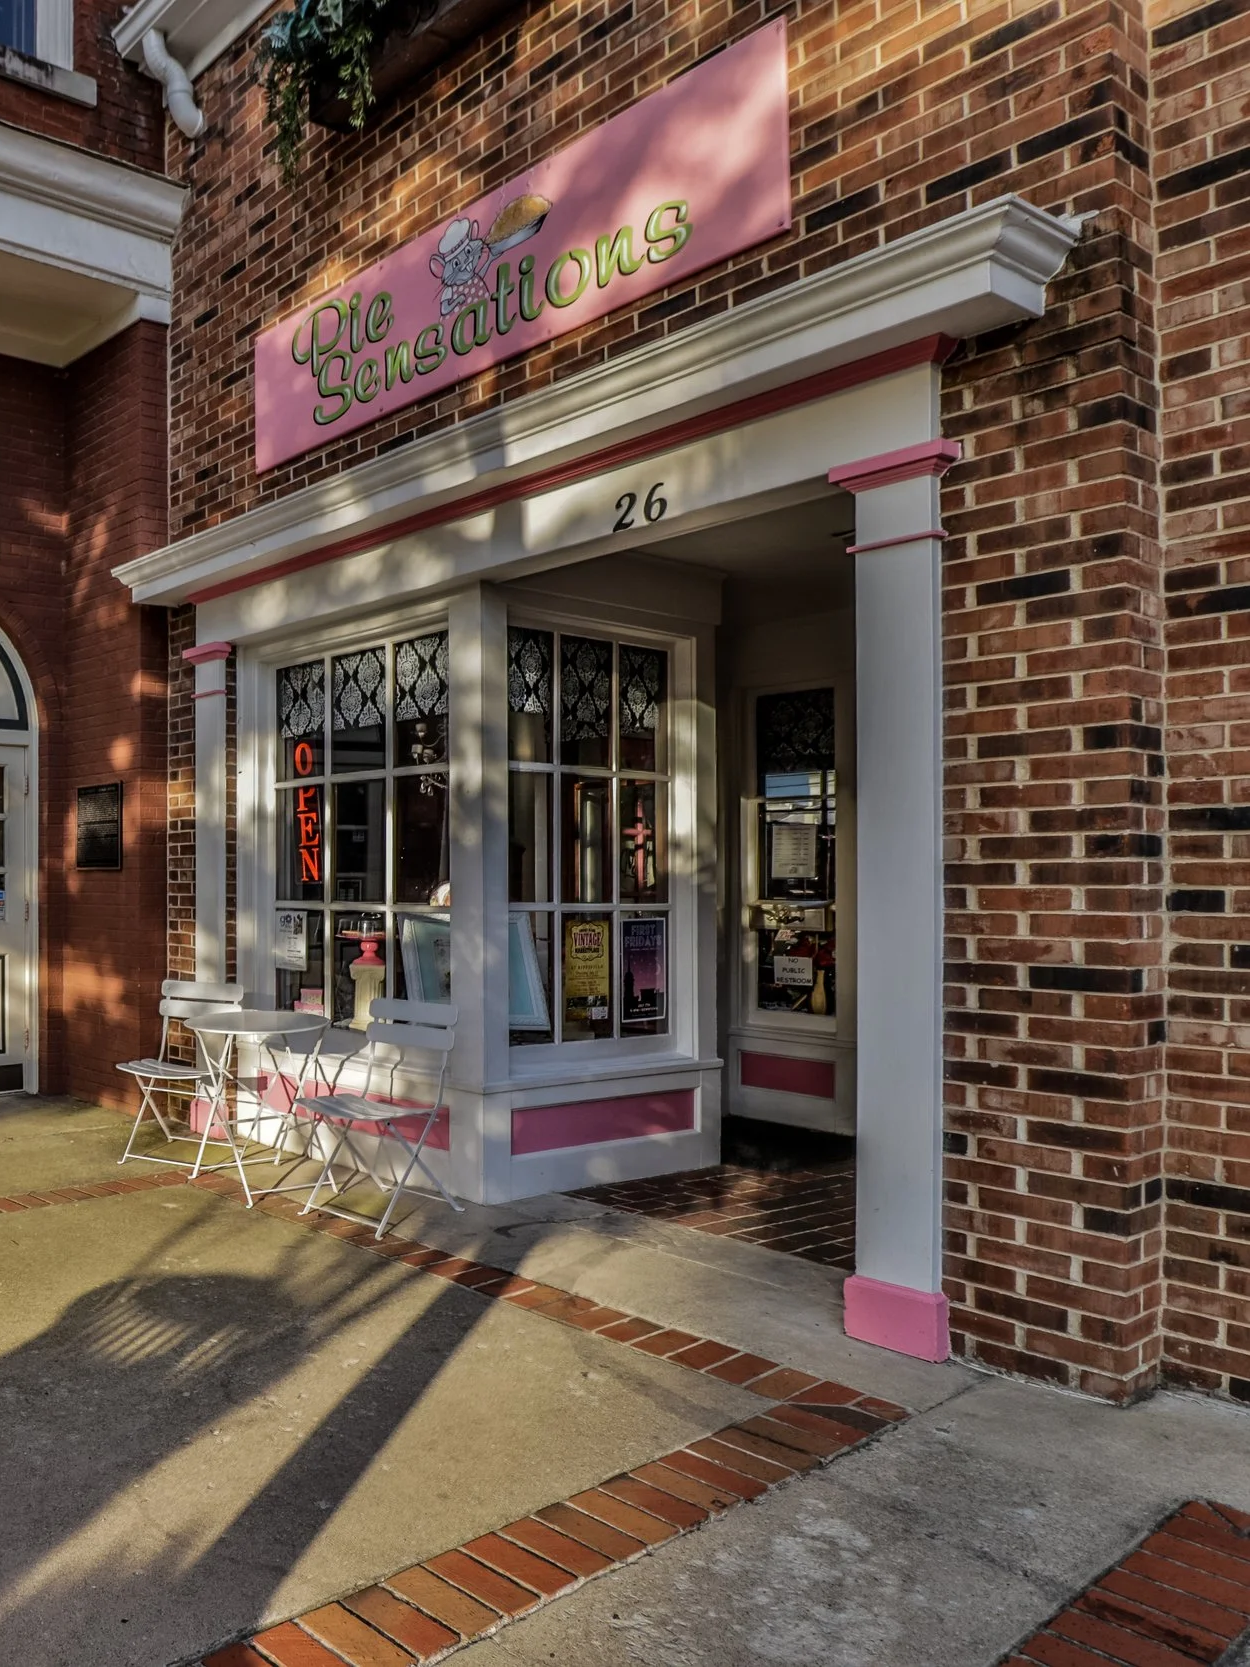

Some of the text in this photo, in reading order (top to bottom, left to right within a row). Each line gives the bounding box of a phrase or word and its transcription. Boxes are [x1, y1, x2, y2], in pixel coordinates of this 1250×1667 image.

[314, 199, 694, 426] Sensations
[292, 291, 394, 377] Pie
[612, 482, 668, 533] 26
[294, 742, 320, 882] OPEN
[573, 932, 601, 947] VINTAGE
[624, 935, 663, 947] FRIDAYS
[631, 924, 656, 935] FIRST
[776, 976, 812, 984] RESTROOM
